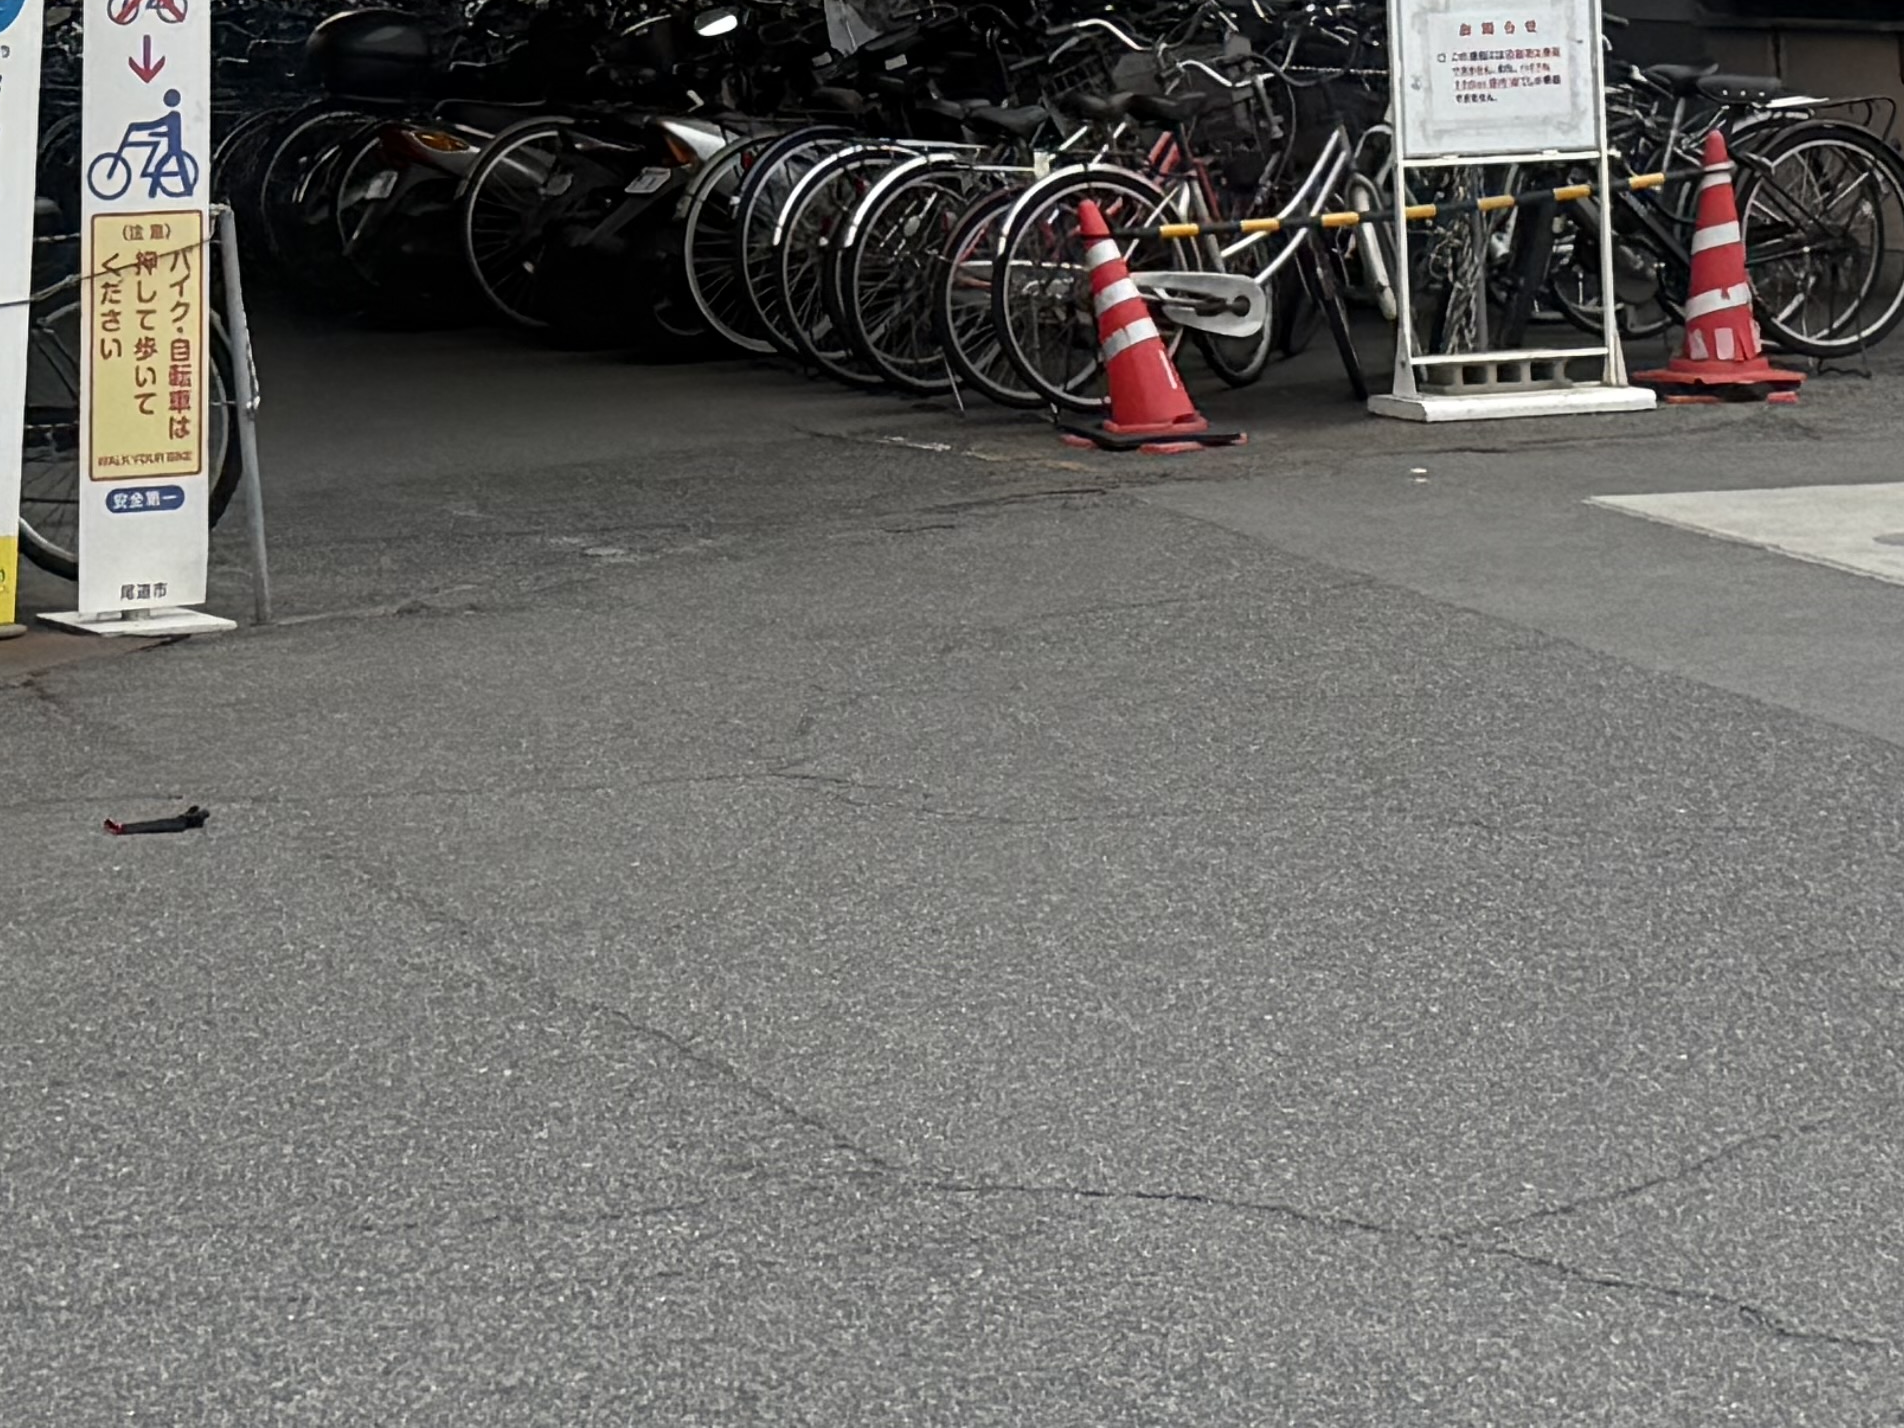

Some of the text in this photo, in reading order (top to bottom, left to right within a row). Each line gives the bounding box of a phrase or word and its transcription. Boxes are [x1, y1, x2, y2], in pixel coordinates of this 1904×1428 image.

[100, 252, 123, 361] ください
[132, 250, 158, 415] 押して歩いて
[167, 249, 193, 441] バイク・自転車は
